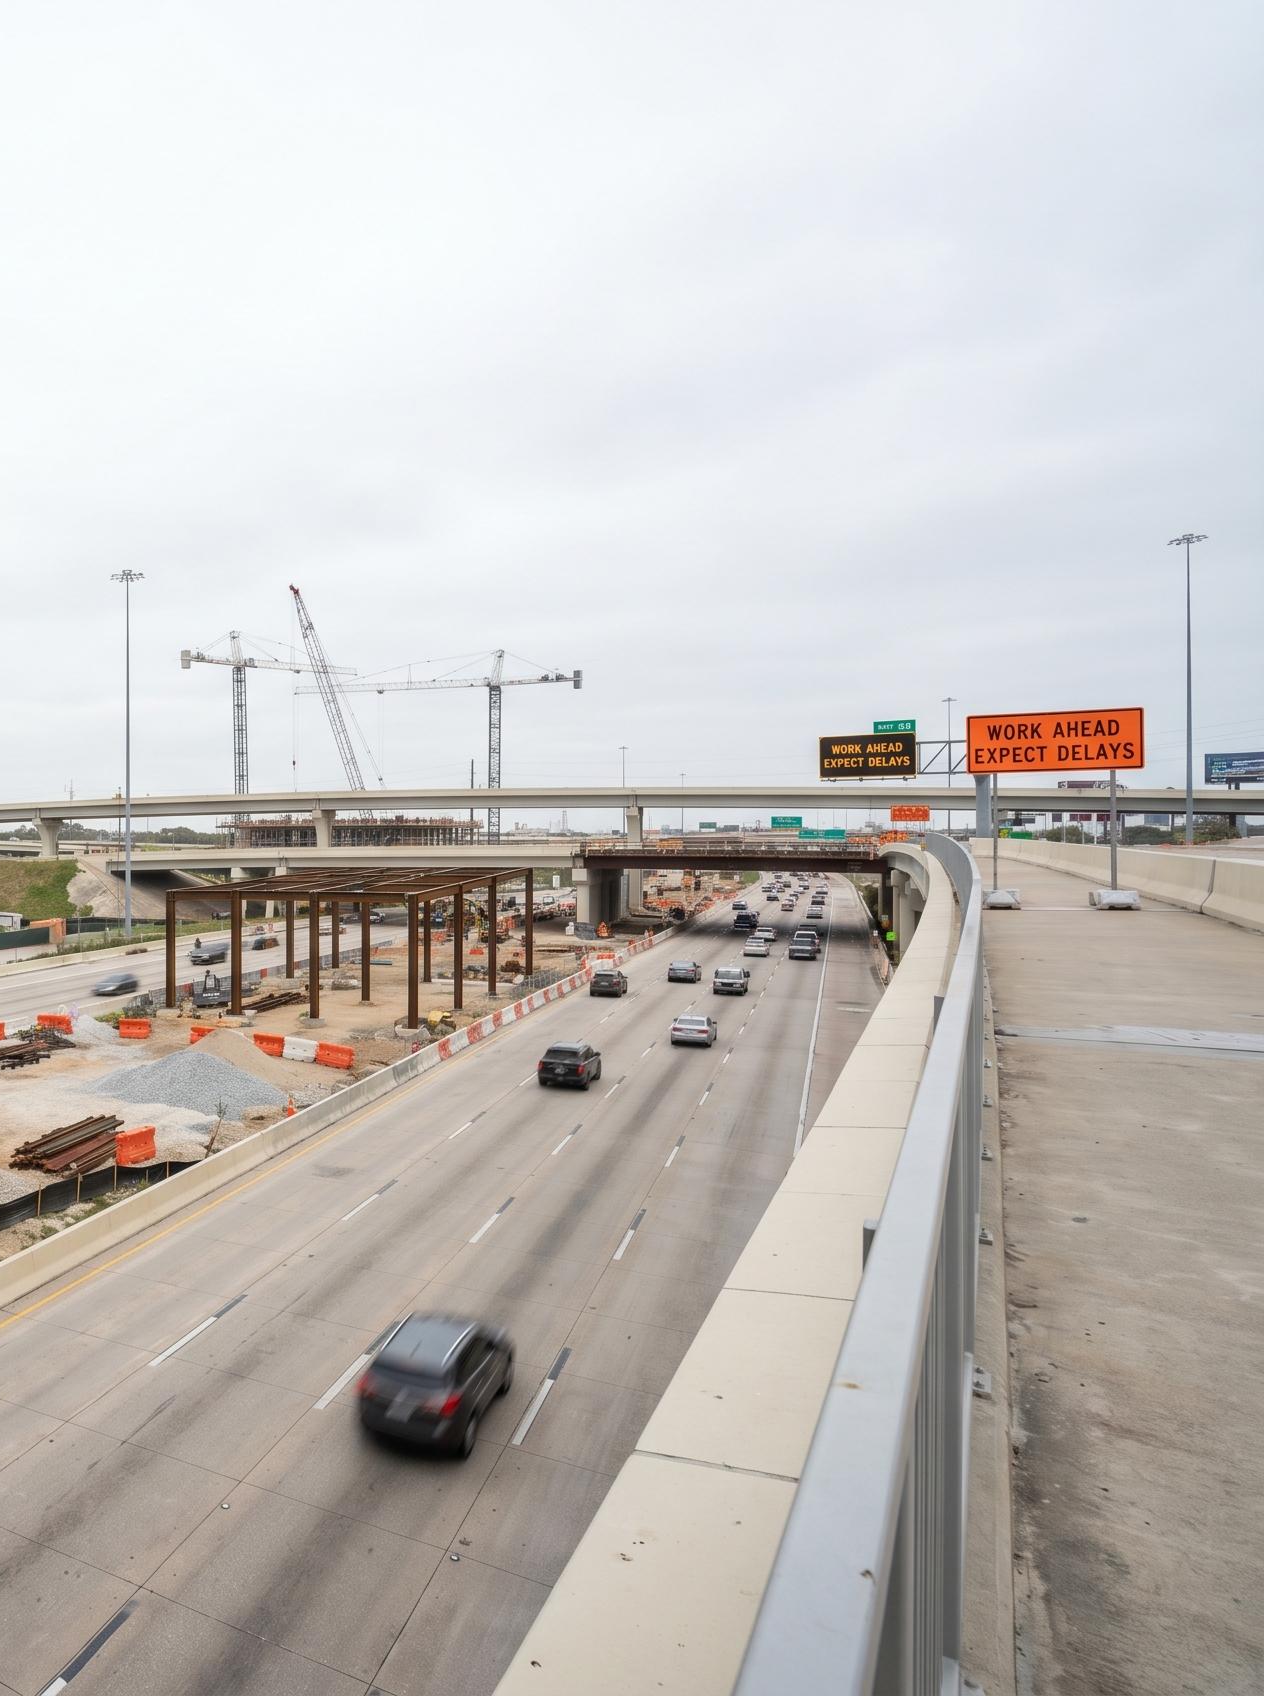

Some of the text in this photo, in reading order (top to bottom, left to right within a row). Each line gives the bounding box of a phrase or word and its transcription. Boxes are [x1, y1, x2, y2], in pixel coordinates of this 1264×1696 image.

[987, 719, 1120, 741] WORK AHEAD
[831, 742, 903, 754] WORK AHEAD
[974, 742, 1135, 764] EXPECT DELAYS
[824, 756, 910, 768] EXPECT DELAYS
